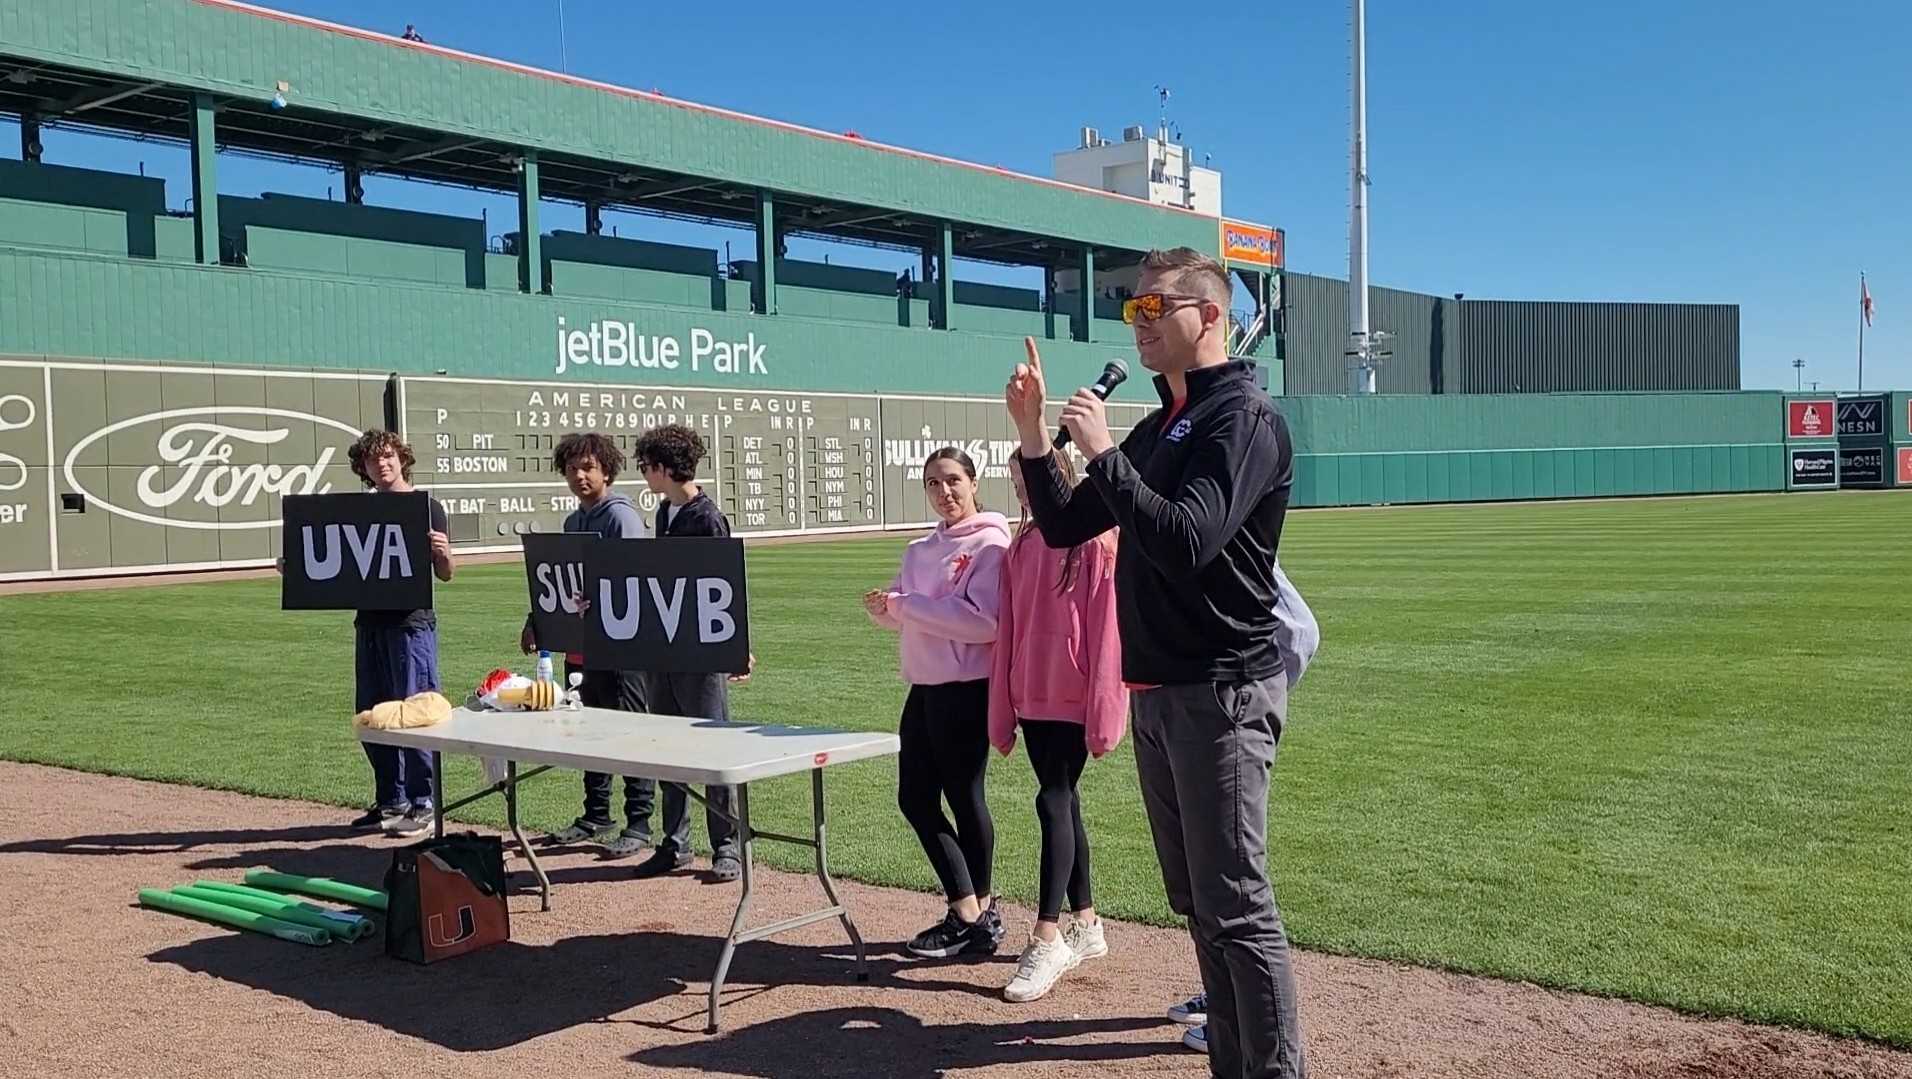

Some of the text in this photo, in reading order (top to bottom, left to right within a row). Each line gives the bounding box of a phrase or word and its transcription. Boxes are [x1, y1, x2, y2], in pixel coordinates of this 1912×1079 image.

[556, 317, 768, 375] jetBlue Park
[528, 391, 812, 413] AMERICAN LEAGUE
[437, 408, 448, 425] P
[685, 414, 693, 428] H
[702, 414, 709, 429] E
[724, 415, 793, 430] P IN R
[807, 417, 871, 431] P IN R
[436, 433, 494, 449] 50 PIT
[743, 437, 762, 450] DET
[825, 437, 841, 449] STL
[137, 422, 336, 508] Ford
[437, 457, 507, 473] 55 BOSTON
[745, 452, 762, 464] ATL
[825, 452, 843, 464] WSH
[746, 467, 762, 480] MIN
[825, 467, 843, 479] HOU
[906, 466, 1011, 480] AN SERV
[748, 483, 761, 494] TB
[825, 481, 844, 493] NYM
[460, 498, 486, 513] BAT
[501, 497, 535, 512] BALL
[551, 495, 581, 511] STRI
[745, 498, 765, 510] NYY
[828, 496, 842, 507] PHI
[746, 513, 765, 525] TOR
[828, 510, 842, 521] MIA
[302, 523, 413, 581] UVA
[536, 562, 584, 614] SU
[600, 576, 736, 644] UVB
[429, 905, 476, 947] U
